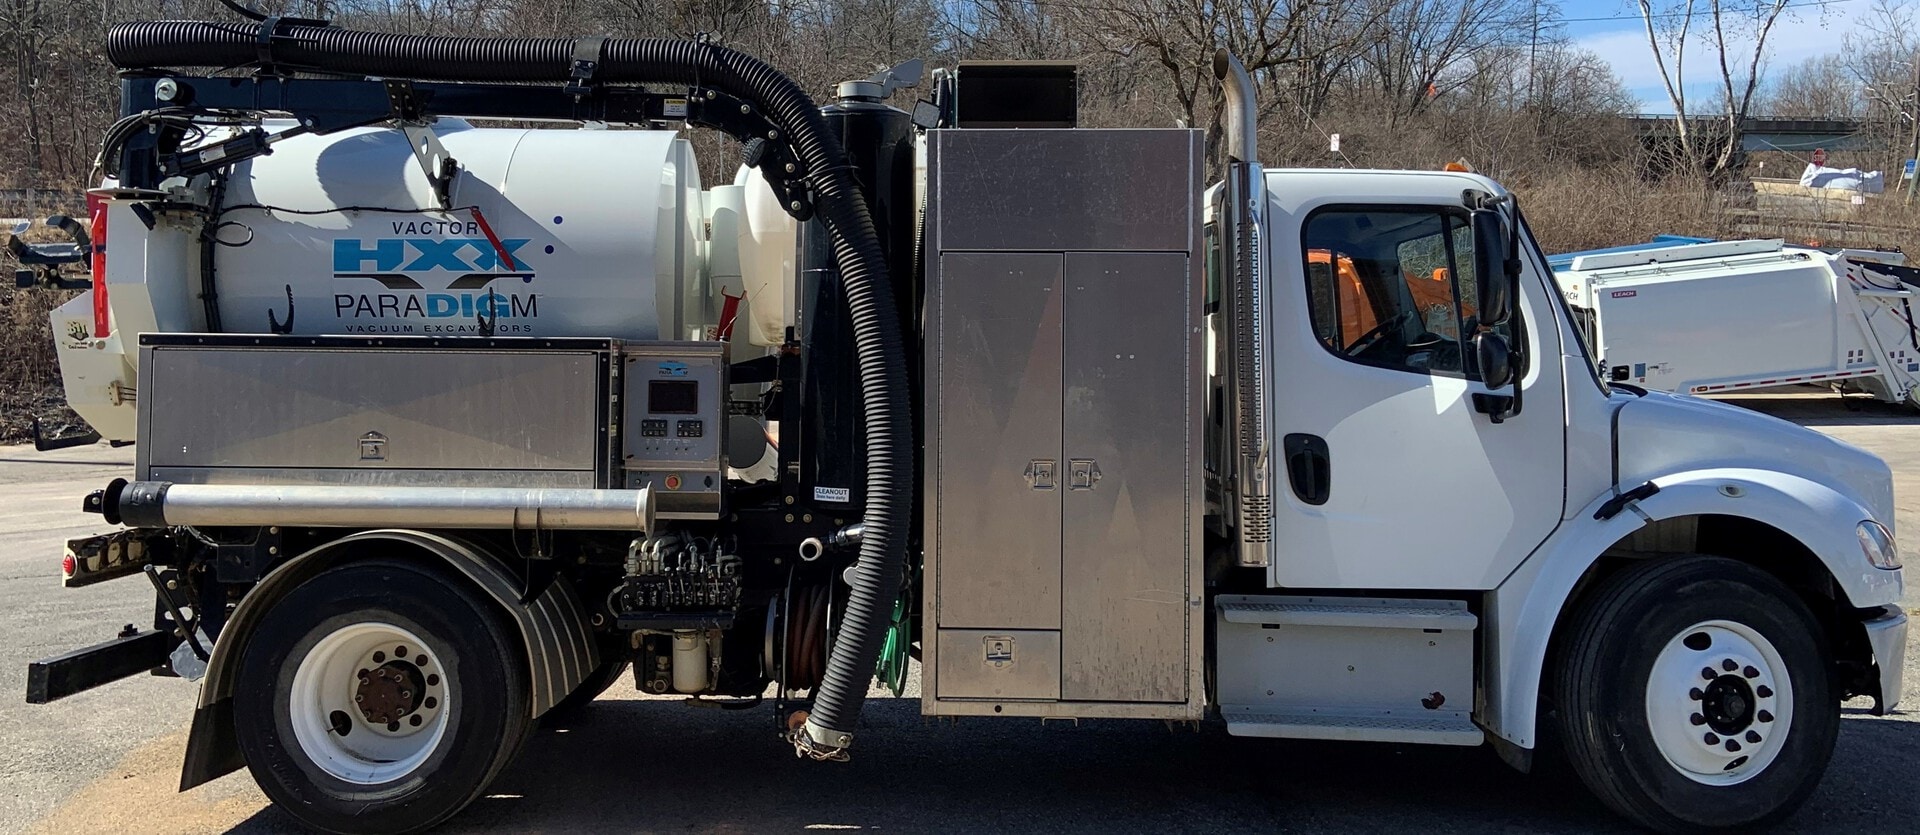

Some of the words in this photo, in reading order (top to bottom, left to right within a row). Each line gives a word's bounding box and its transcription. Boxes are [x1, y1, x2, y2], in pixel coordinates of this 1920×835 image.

[392, 222, 478, 235] VACTOR
[333, 239, 535, 271] HXX
[334, 293, 538, 318] PARADIGM
[345, 325, 414, 333] VACUUM
[424, 325, 532, 333] EXCAVORS
